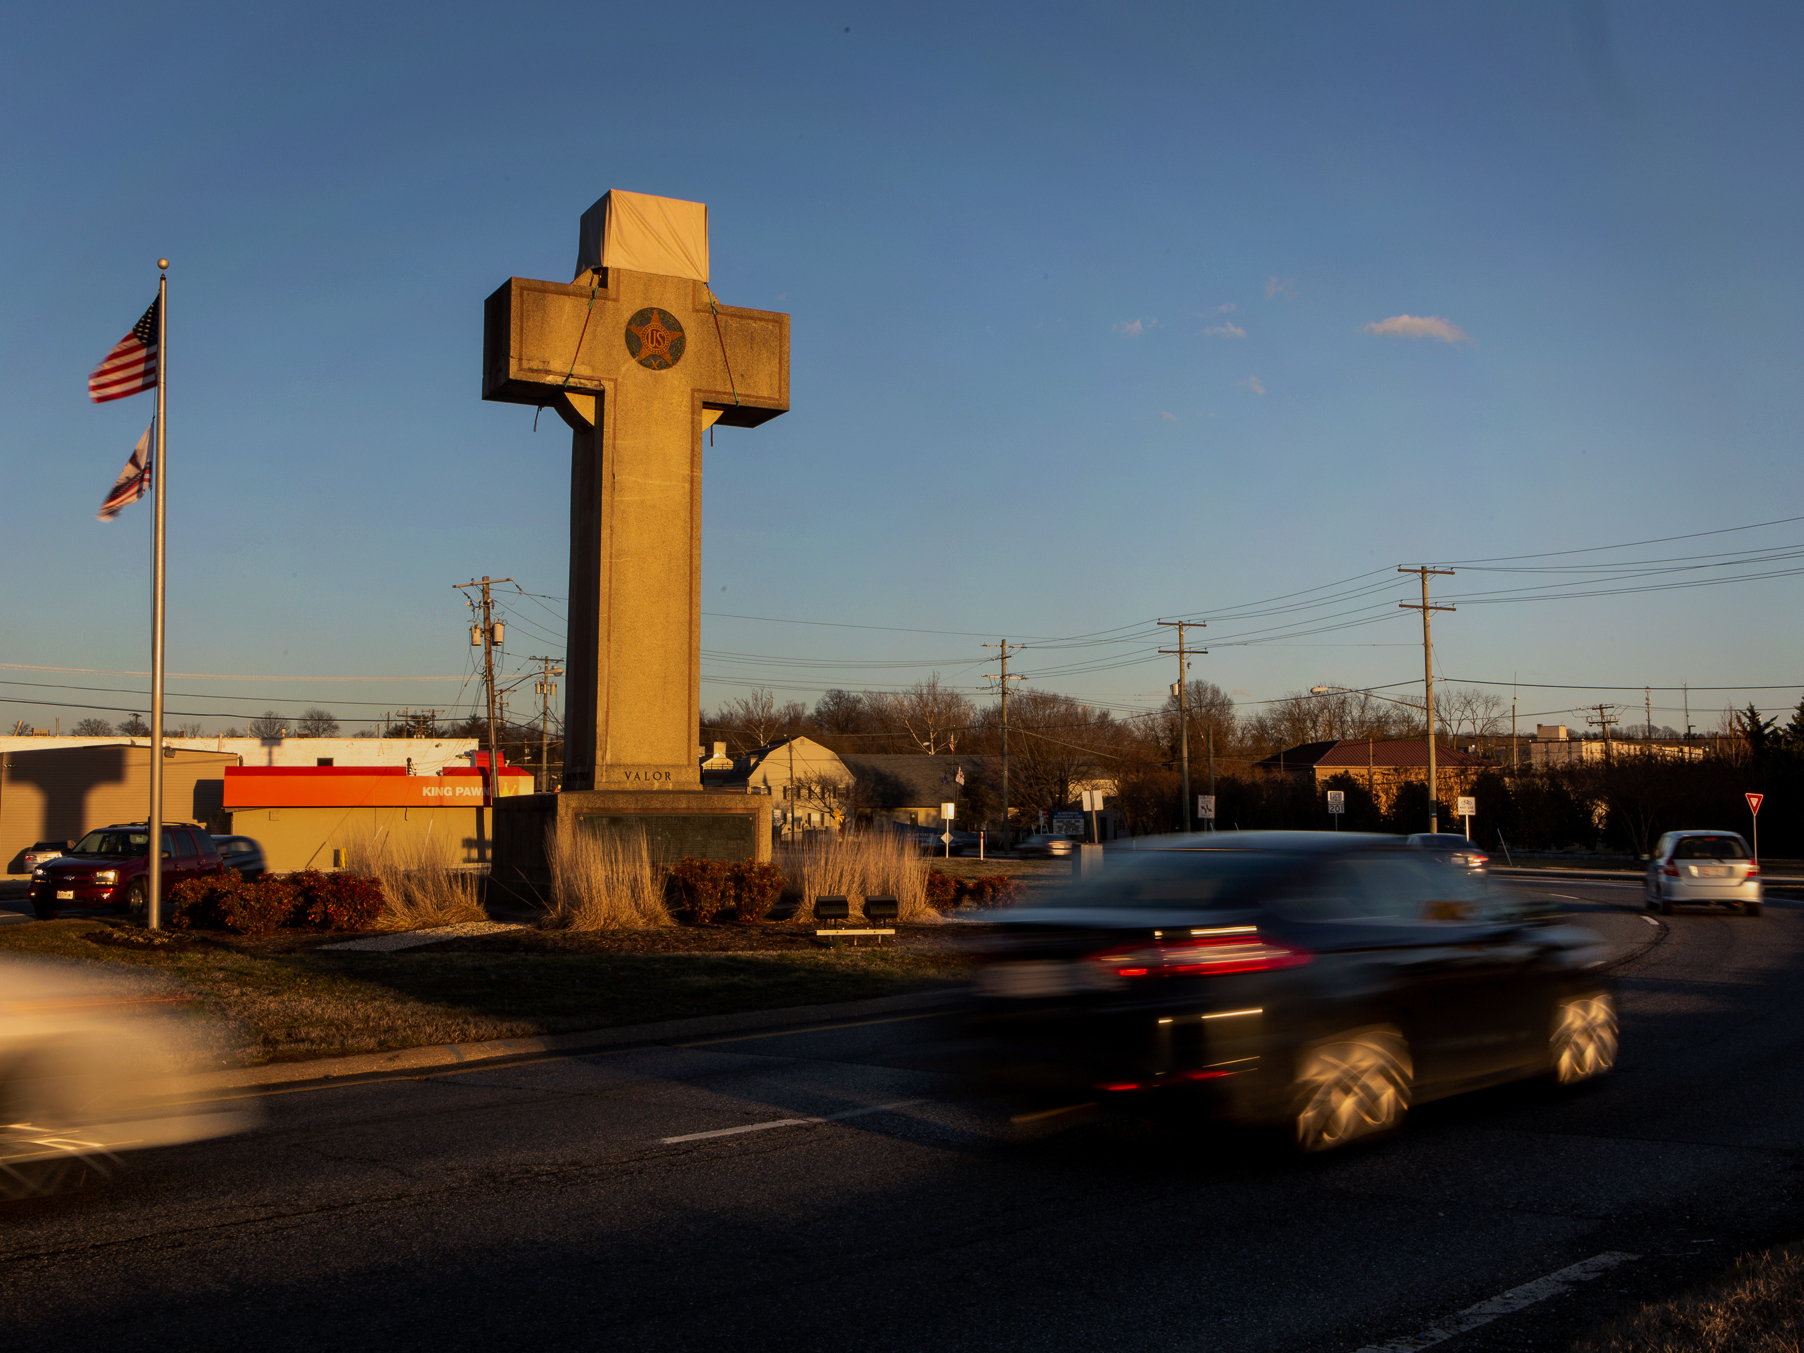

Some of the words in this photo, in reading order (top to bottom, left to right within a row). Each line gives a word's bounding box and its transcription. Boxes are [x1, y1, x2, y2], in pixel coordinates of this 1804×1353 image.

[648, 330, 664, 348] US
[624, 771, 672, 781] VALOR
[422, 786, 453, 797] KING
[455, 786, 491, 797] PAWN
[1329, 804, 1344, 813] 201
